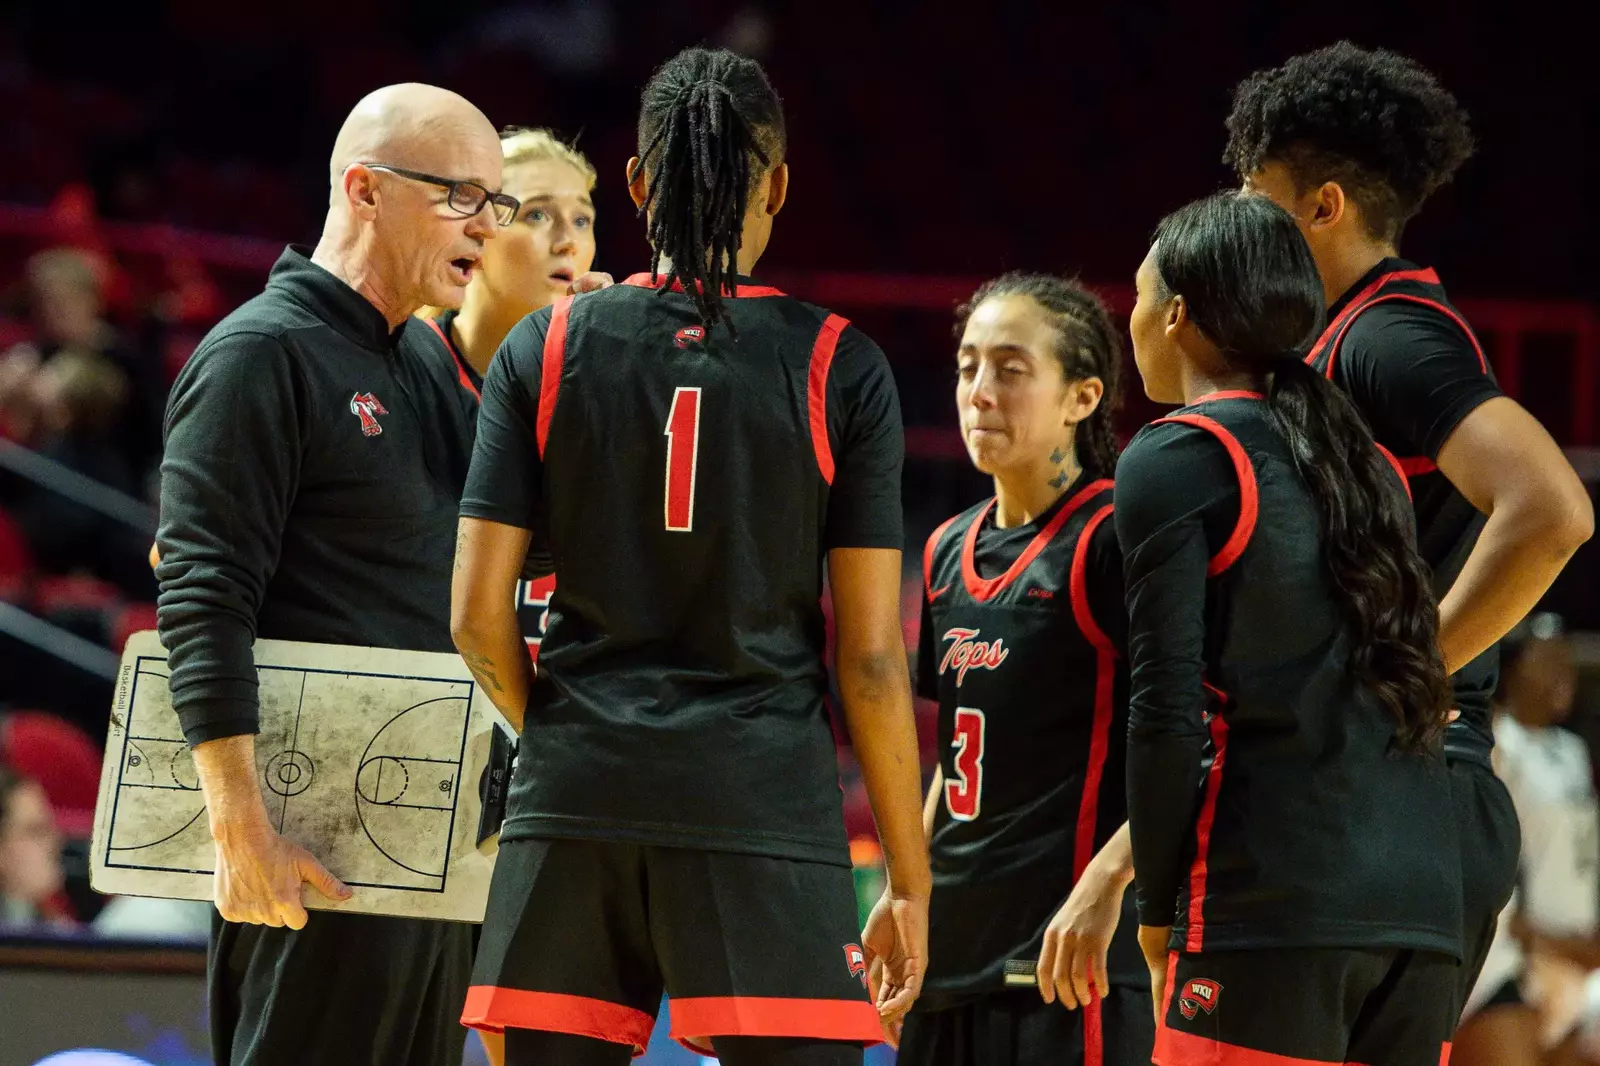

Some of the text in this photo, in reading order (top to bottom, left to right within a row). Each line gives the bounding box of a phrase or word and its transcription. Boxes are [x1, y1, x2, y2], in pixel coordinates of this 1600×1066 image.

[684, 329, 701, 337] WKU
[664, 386, 702, 533] 1
[938, 627, 1010, 688] Tops
[117, 664, 132, 710] Basketball
[944, 706, 986, 822] 3
[1191, 983, 1213, 1000] WKU
